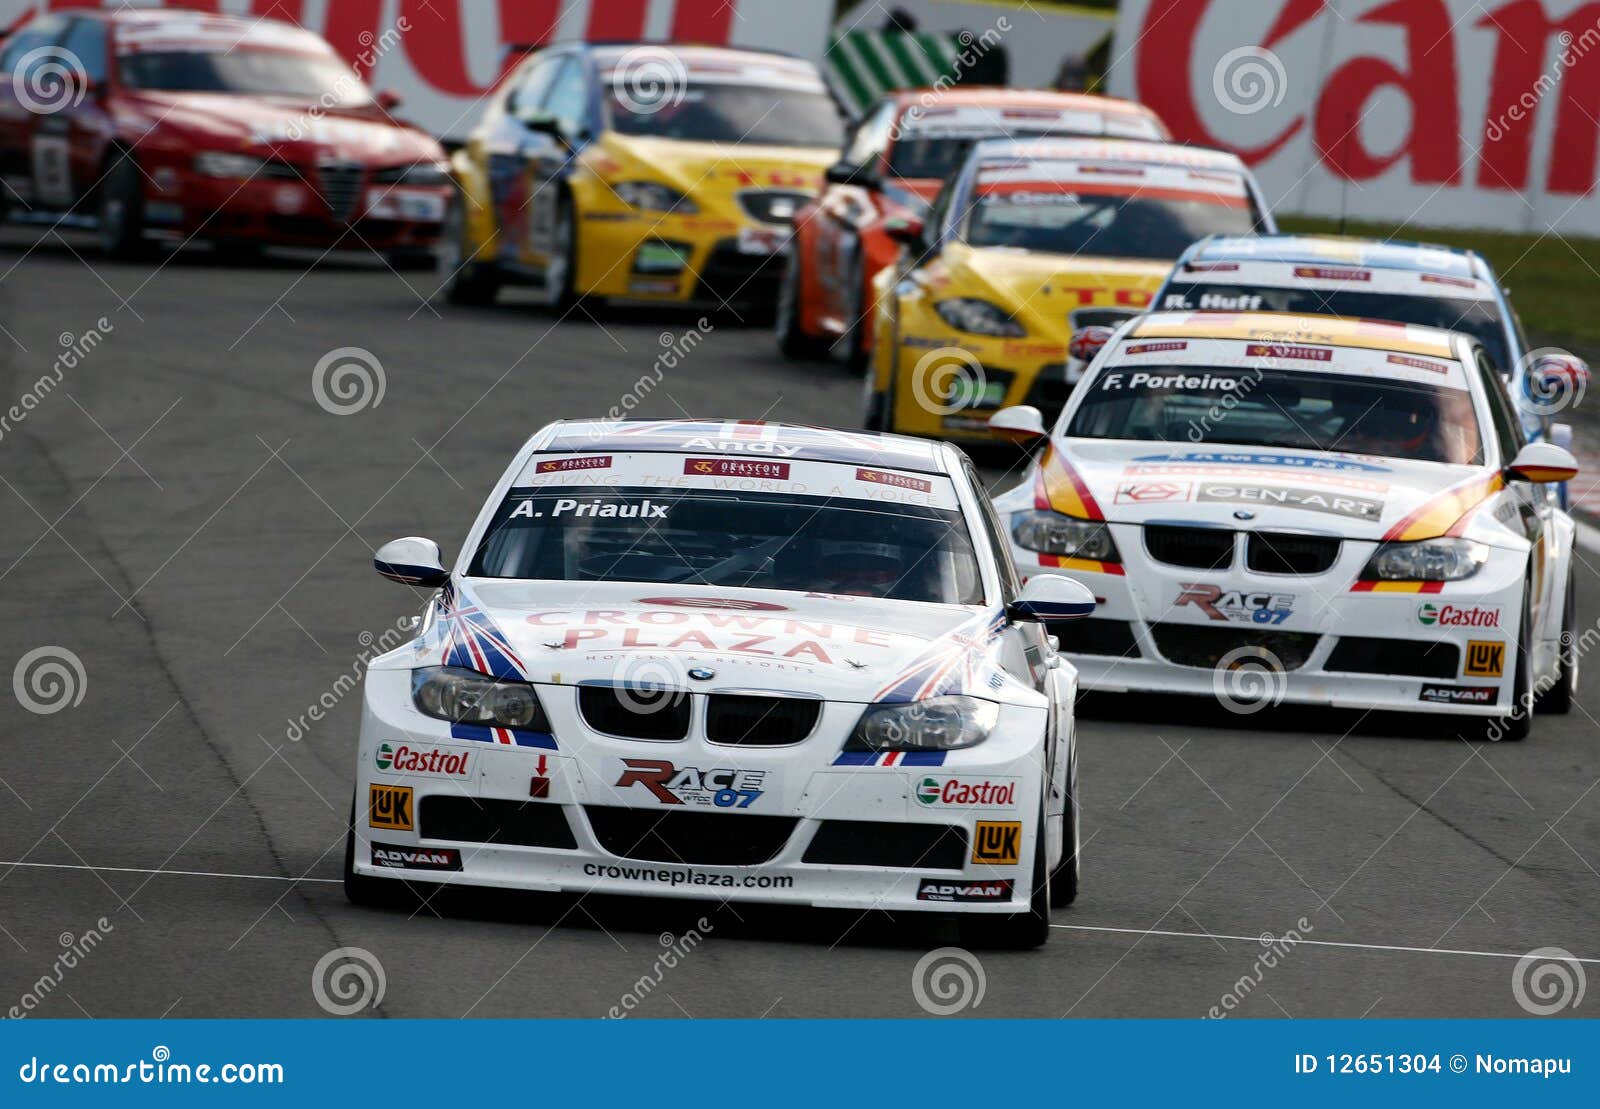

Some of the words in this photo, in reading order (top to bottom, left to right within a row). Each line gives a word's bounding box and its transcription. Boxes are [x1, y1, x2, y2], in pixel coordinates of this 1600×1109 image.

[1165, 294, 1192, 309] R.
[1200, 293, 1263, 309] Huff
[1102, 373, 1122, 391] F.
[1130, 372, 1236, 391] Porteiro
[680, 437, 804, 458] Andy
[721, 461, 781, 475] ORASCOM
[531, 474, 620, 486] GIVING
[639, 474, 691, 487] THE
[713, 478, 808, 494] WORLD
[831, 485, 844, 497] A
[865, 487, 938, 505] VOICE
[508, 500, 543, 519] A.
[552, 499, 669, 519] Priaulx
[1206, 487, 1377, 515] GEN-ART
[1439, 605, 1500, 628] Castrol
[525, 609, 891, 649] CROWNE
[563, 627, 834, 665] PLAZA
[716, 657, 815, 674] RESORTS
[1422, 688, 1489, 700] ADVAN
[394, 746, 469, 775] Castrol
[614, 758, 767, 805] RACE
[942, 779, 1015, 805] Castrol
[713, 789, 765, 808] 07
[374, 849, 449, 864] ADVAN
[583, 863, 794, 888] crowneplaza.com
[921, 885, 1002, 896] ADVAN
